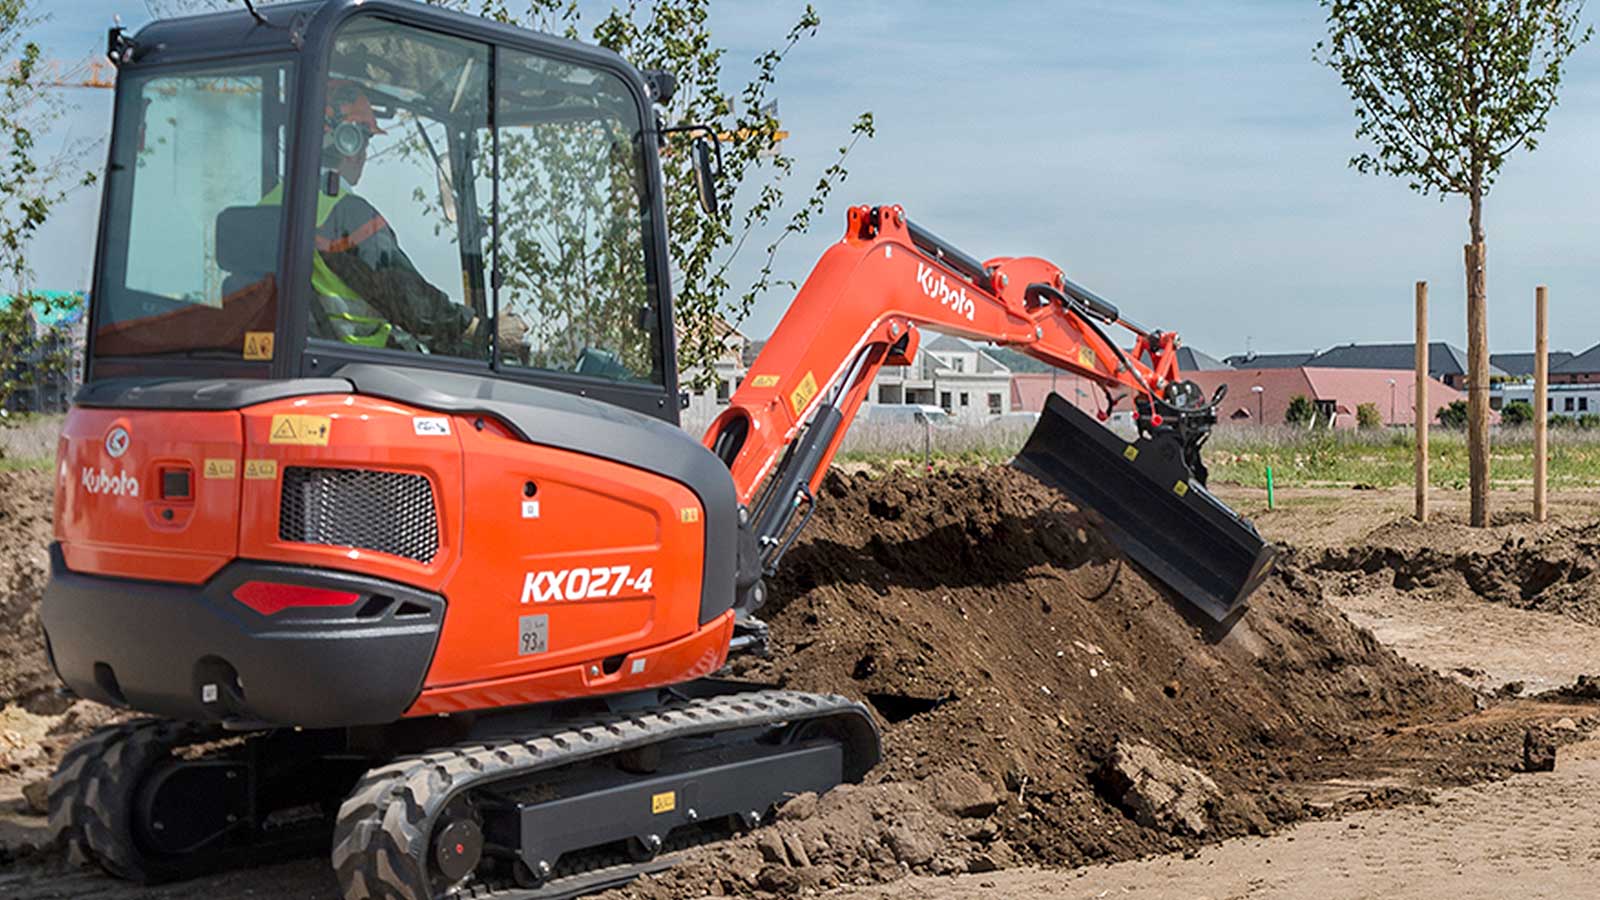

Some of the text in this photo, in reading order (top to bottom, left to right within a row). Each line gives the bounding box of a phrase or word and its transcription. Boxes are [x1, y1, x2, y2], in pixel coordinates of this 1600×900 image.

[917, 262, 975, 321] Kubota
[82, 467, 139, 496] Kubota
[520, 565, 653, 603] KX027-4
[522, 632, 538, 652] 93
